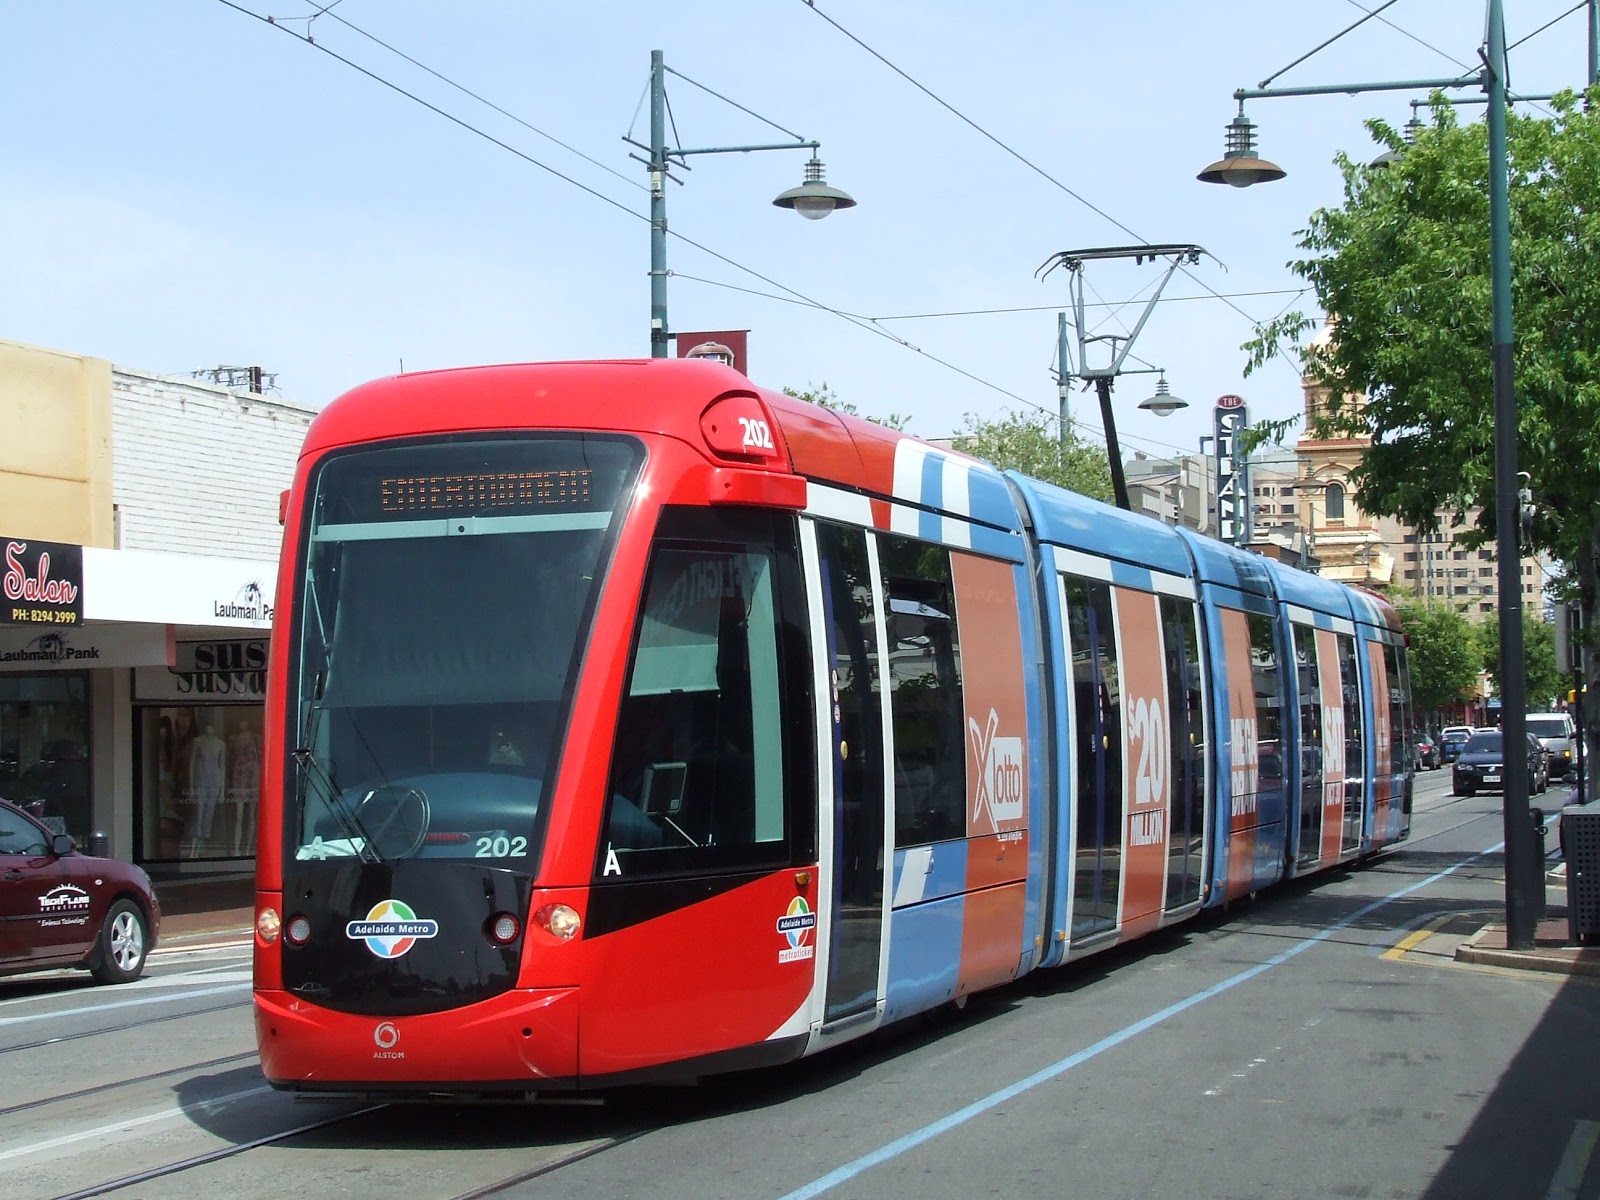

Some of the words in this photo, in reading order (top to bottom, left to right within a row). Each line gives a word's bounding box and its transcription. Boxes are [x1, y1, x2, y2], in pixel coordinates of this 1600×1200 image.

[1222, 397, 1238, 406] THE
[738, 417, 773, 449] 202
[4, 541, 78, 604] Salon
[12, 608, 29, 621] PH:
[31, 609, 53, 622] 8294
[54, 611, 76, 623] 2999
[214, 600, 257, 620] Laubman
[263, 604, 274, 620] Pa
[66, 647, 100, 660] Pank
[195, 642, 266, 671] sus
[1128, 693, 1164, 804] $20
[1130, 808, 1164, 847] MILLION
[304, 835, 326, 861] A
[475, 836, 528, 858] 202
[603, 849, 622, 877] A
[354, 924, 395, 934] Adelaide
[398, 924, 429, 933] Metro
[780, 919, 801, 929] Adelaide
[802, 918, 813, 926] Metro
[373, 1051, 405, 1059] ALSTOM
